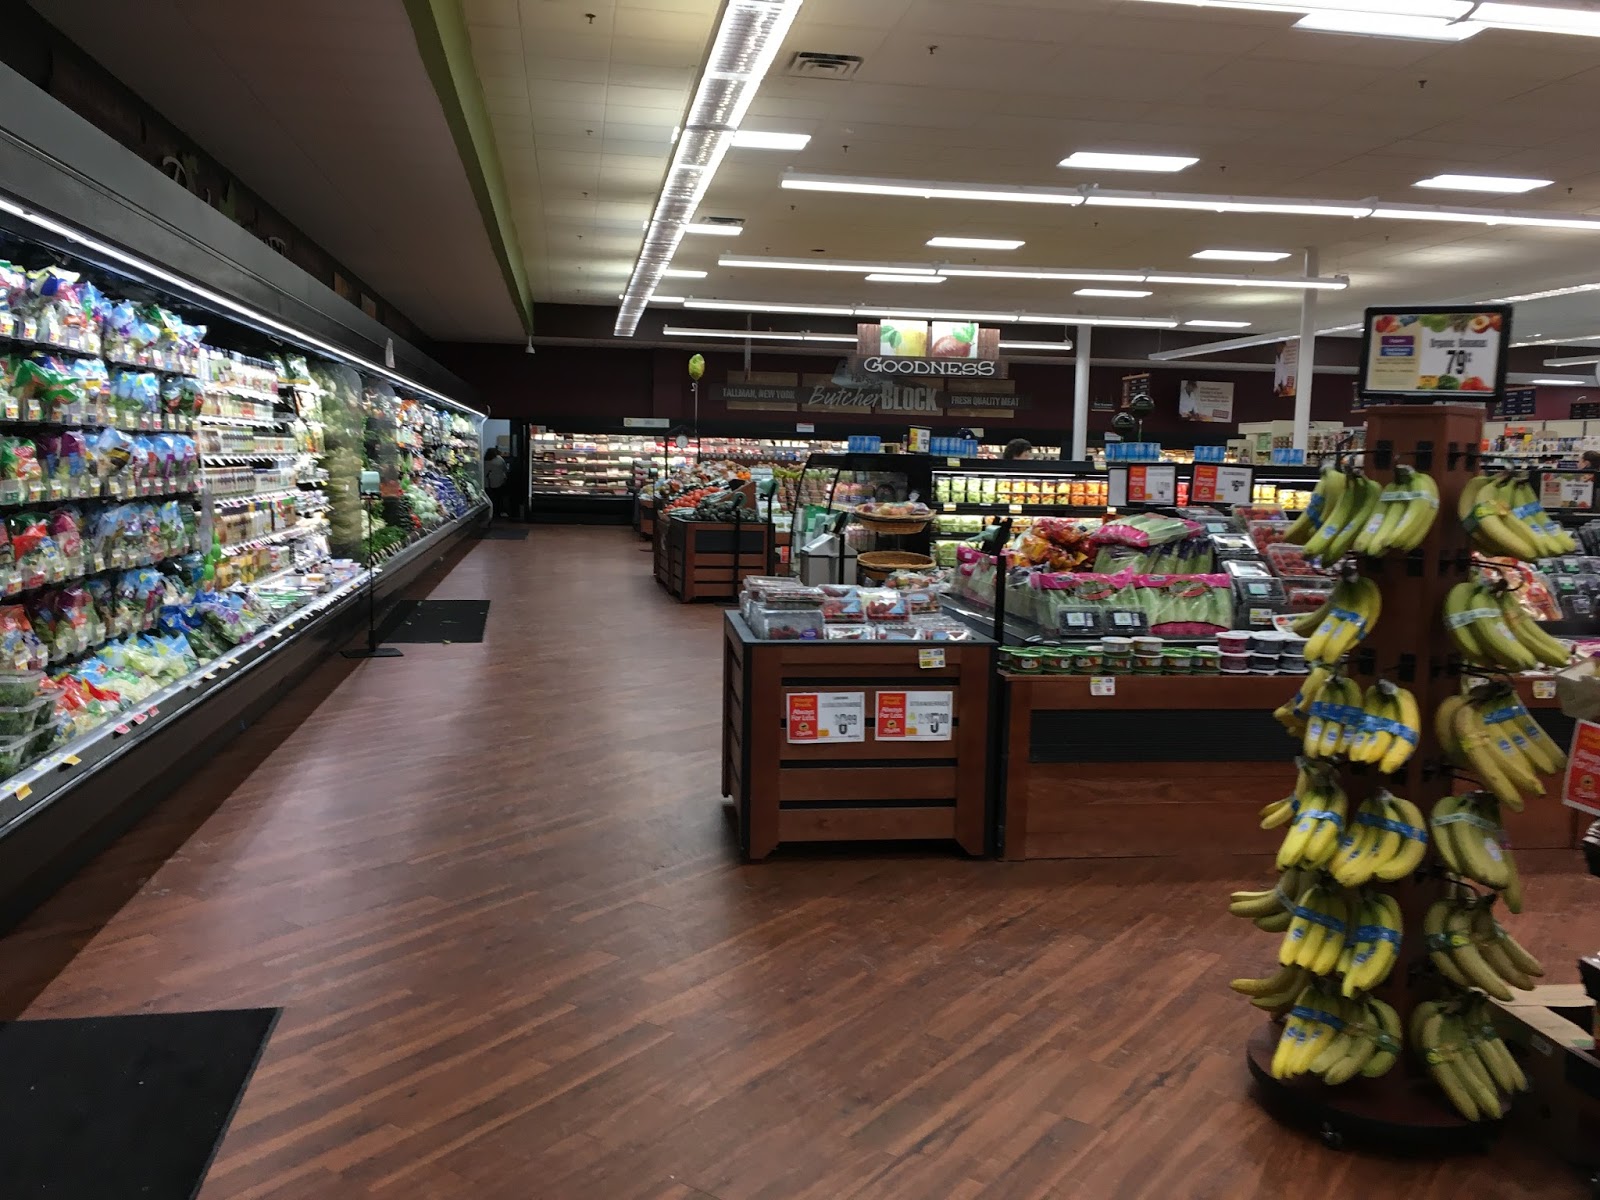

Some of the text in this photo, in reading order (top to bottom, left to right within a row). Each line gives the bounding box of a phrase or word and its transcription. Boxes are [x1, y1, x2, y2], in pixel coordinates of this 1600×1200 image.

[863, 356, 996, 377] GOODNESS
[758, 389, 776, 399] NEW
[776, 390, 795, 400] YORK
[807, 384, 881, 408] Butcher
[880, 379, 938, 411] BLOCK
[951, 395, 1019, 407] FRESH QUALITY MEAT
